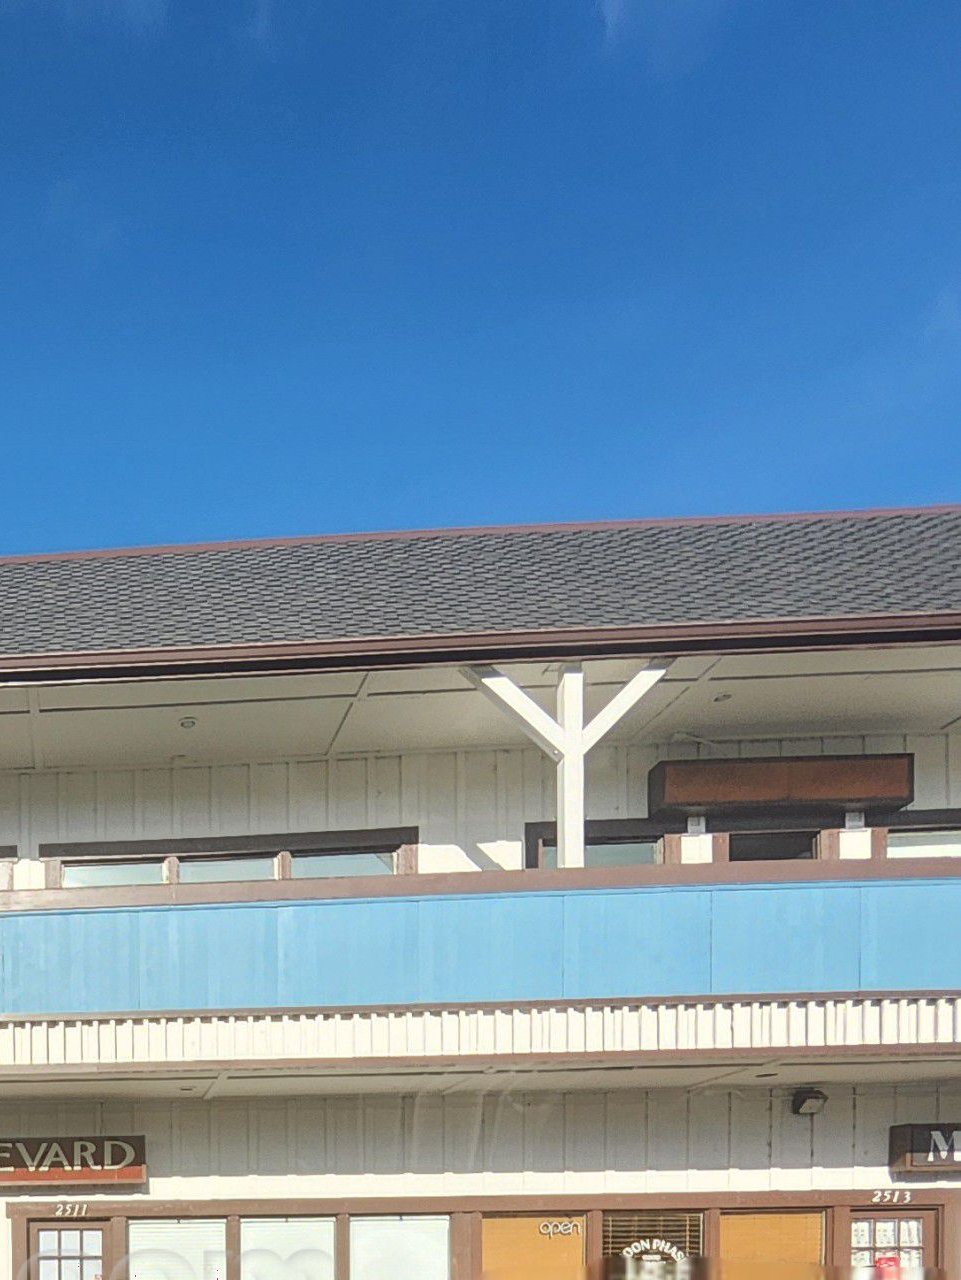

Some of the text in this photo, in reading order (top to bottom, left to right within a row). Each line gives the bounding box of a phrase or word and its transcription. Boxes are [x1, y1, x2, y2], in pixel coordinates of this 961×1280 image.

[871, 1190, 912, 1204] 2513
[55, 1203, 88, 1217] 2511
[539, 1221, 581, 1239] open
[621, 1238, 688, 1263] OON PHAS
